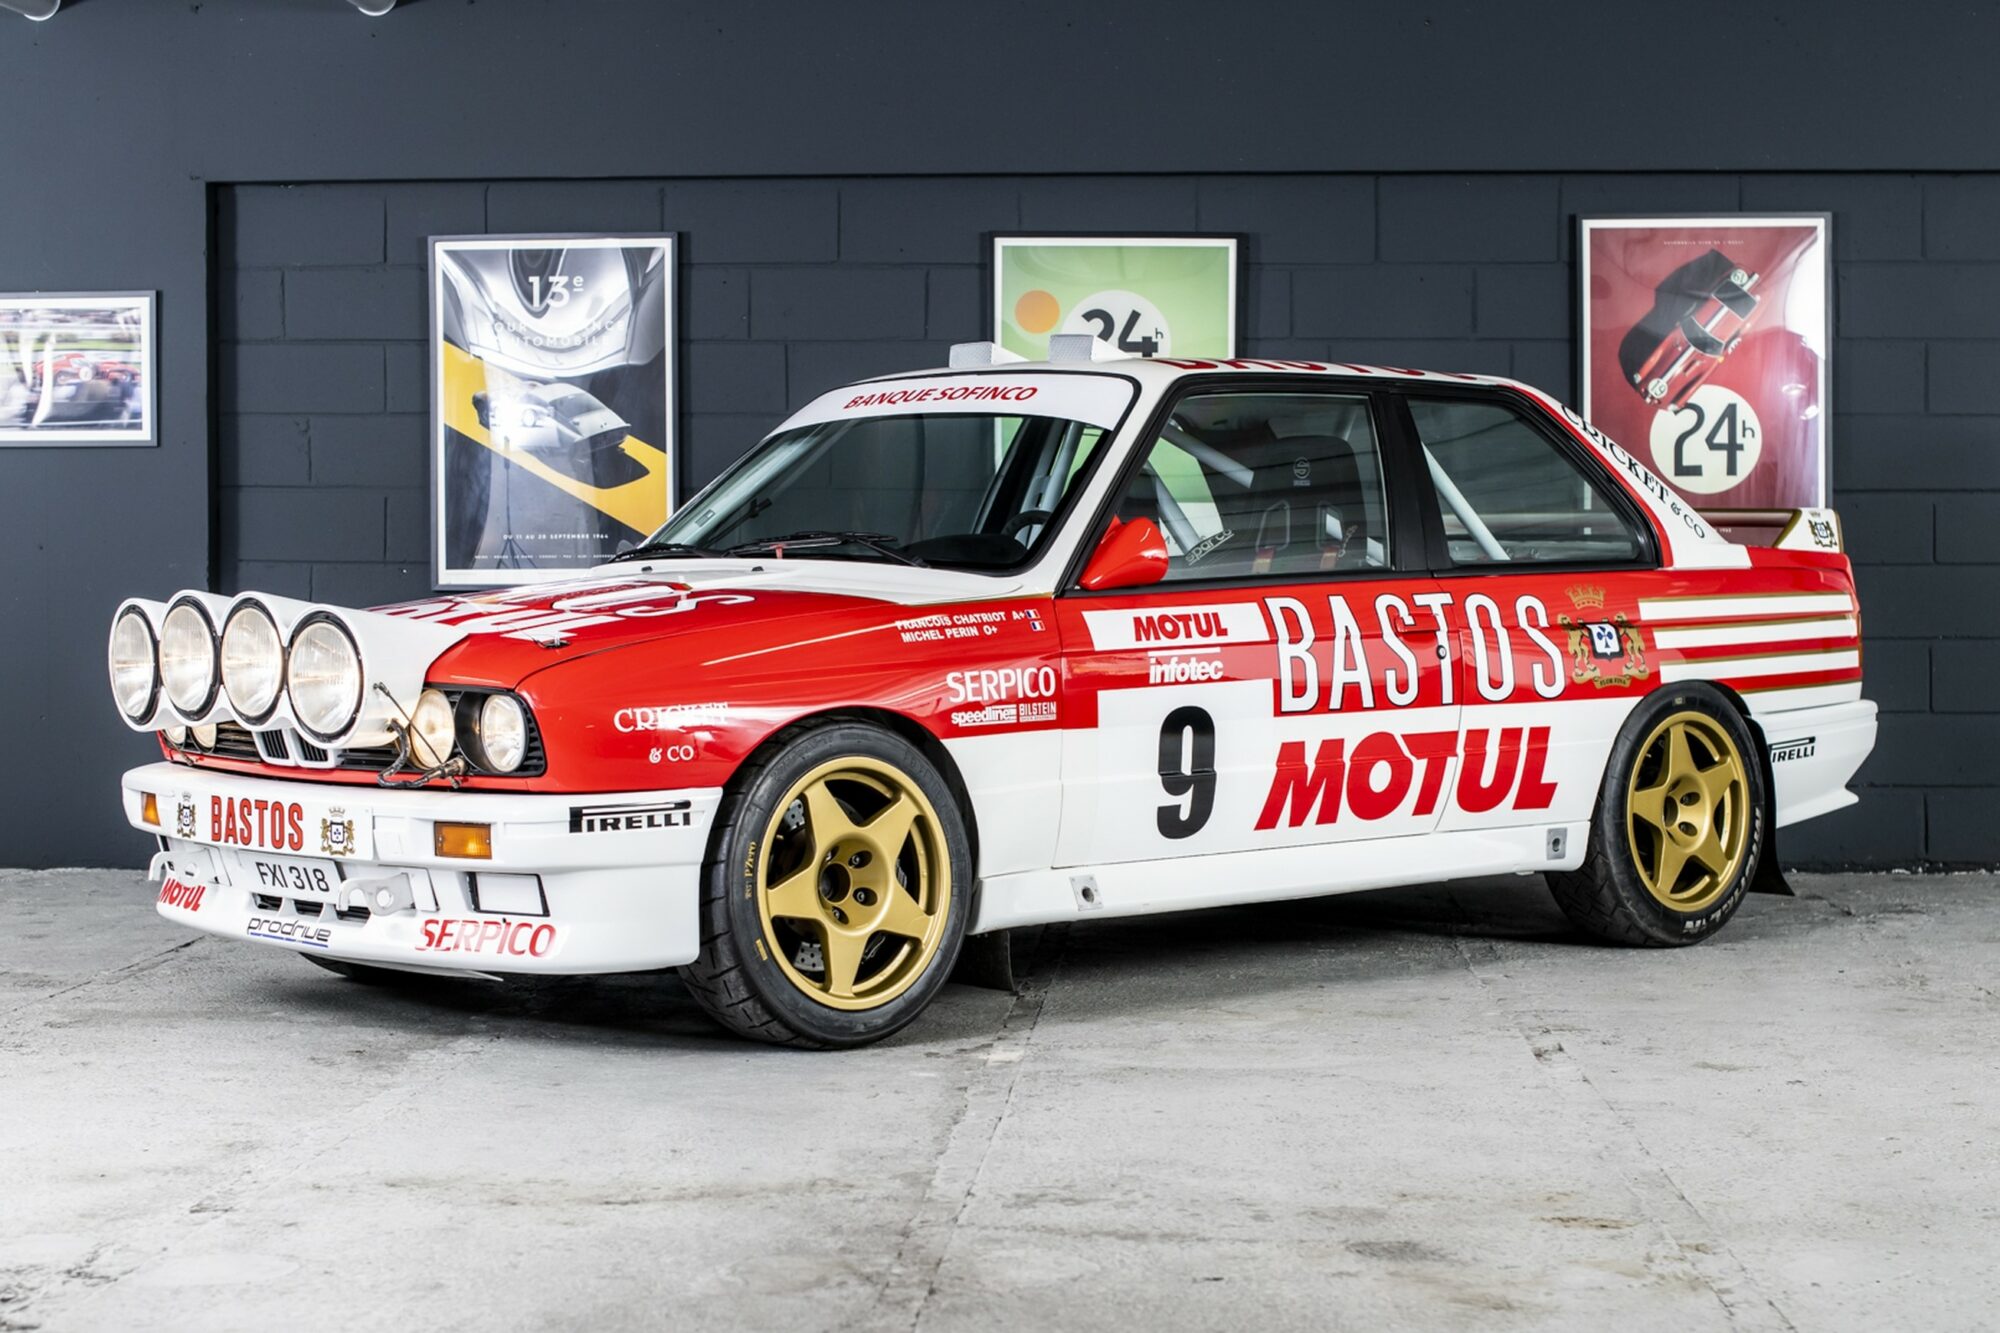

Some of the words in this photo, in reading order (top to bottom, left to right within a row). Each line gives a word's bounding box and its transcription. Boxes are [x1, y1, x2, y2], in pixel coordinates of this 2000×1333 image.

[843, 388, 938, 409] BANQUE
[933, 386, 1038, 401] SOFINCO
[1672, 402, 1755, 477] 24h
[1561, 405, 1669, 504] CRICKET
[1670, 502, 1681, 516] &
[1683, 514, 1706, 539] CO
[901, 627, 946, 643] MICHEL
[945, 626, 979, 639] PERIN
[953, 611, 1006, 625] CHATRIOT
[1133, 612, 1229, 642] MOTUL
[1264, 592, 1566, 712] BASTOS
[946, 666, 1055, 702] SERPICO
[1149, 656, 1224, 684] infotec
[951, 706, 1017, 727] speedline
[1019, 701, 1057, 716] BILSTEIN
[649, 747, 662, 764] &
[667, 745, 694, 762] CO
[1157, 705, 1217, 839] 9
[1254, 726, 1558, 831] MOTUL
[211, 795, 304, 851] BASTOS
[569, 800, 692, 833] PIRELLI
[255, 862, 288, 888] FXI
[288, 866, 330, 892] 318
[157, 877, 206, 912] MOTUL
[247, 918, 332, 942] prodrive
[415, 918, 556, 958] SERPICO
